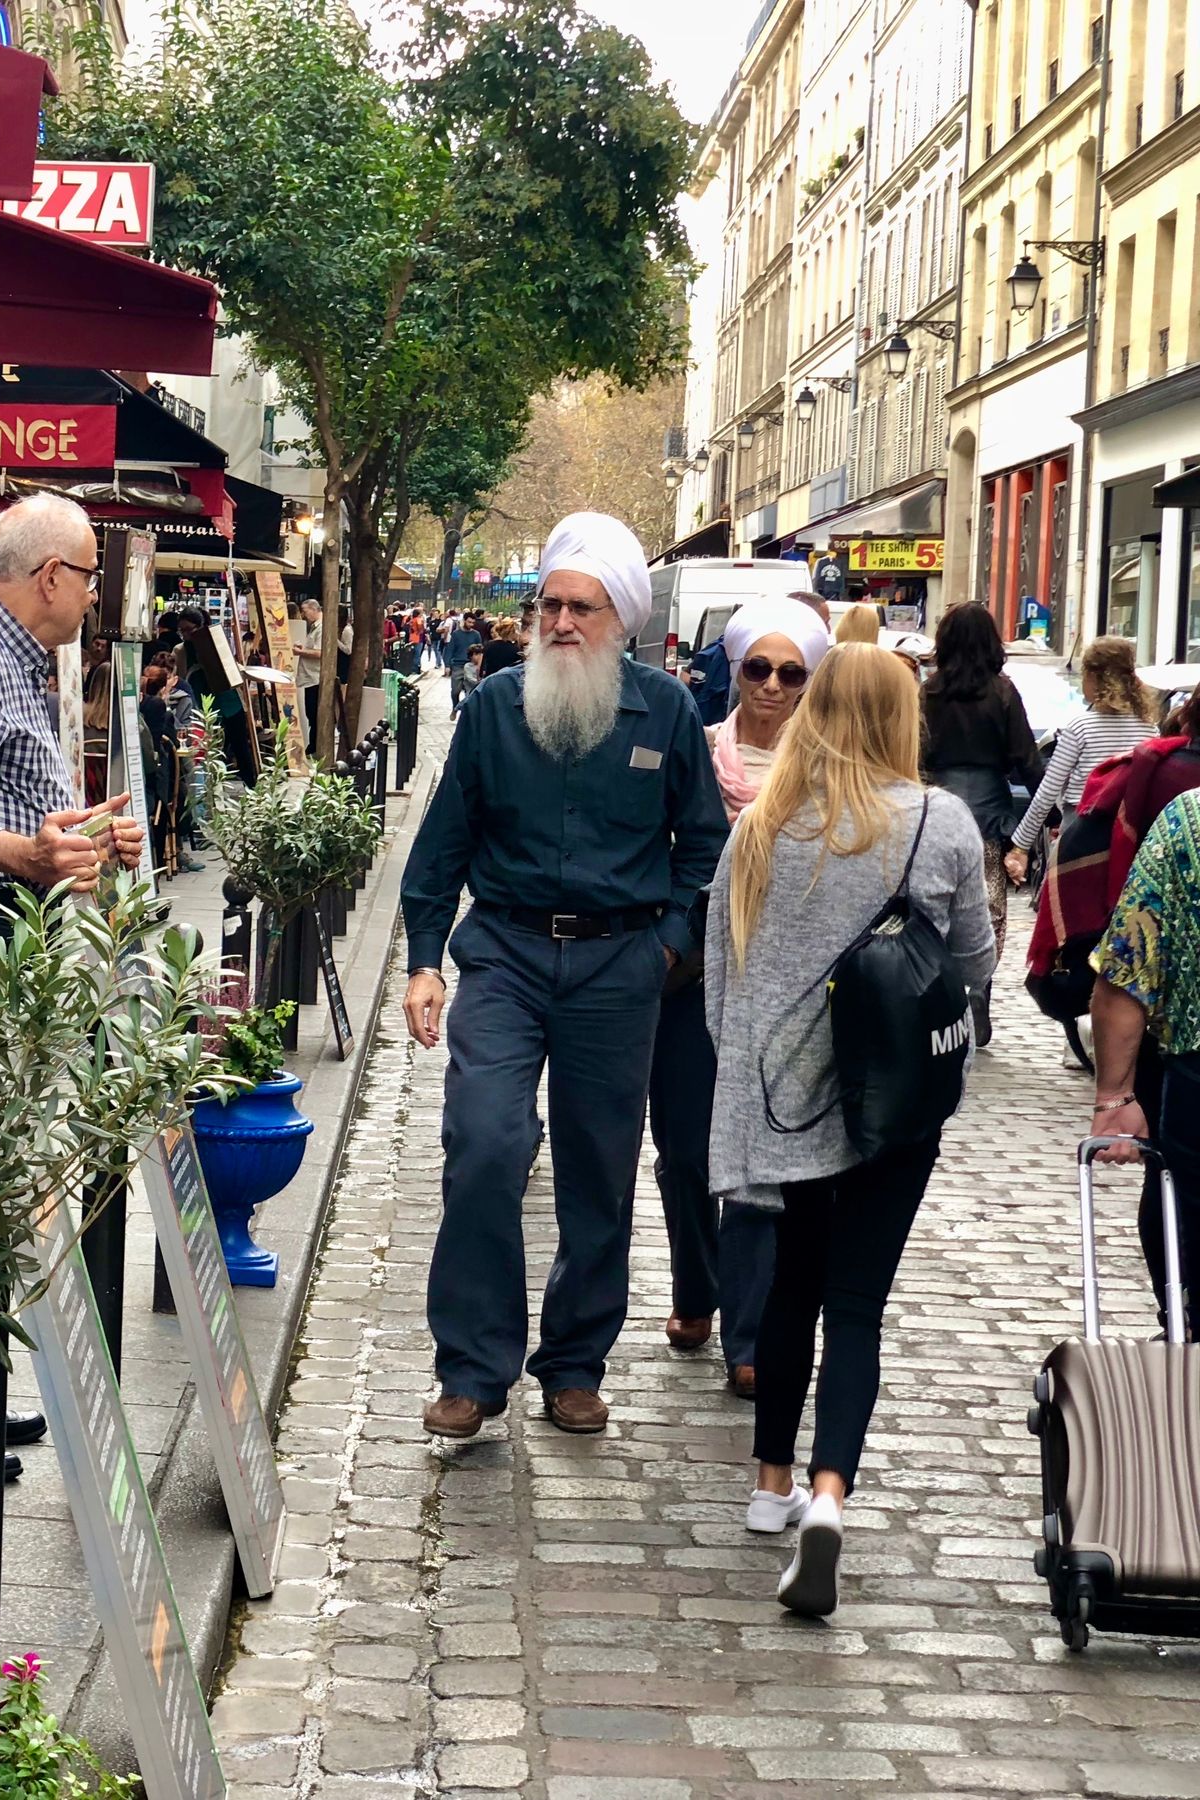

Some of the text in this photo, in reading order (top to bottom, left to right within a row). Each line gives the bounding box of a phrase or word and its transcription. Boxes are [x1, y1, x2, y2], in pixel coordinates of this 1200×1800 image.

[852, 543, 867, 567] 1
[870, 543, 886, 552] TEE
[888, 542, 915, 552] SHIRT
